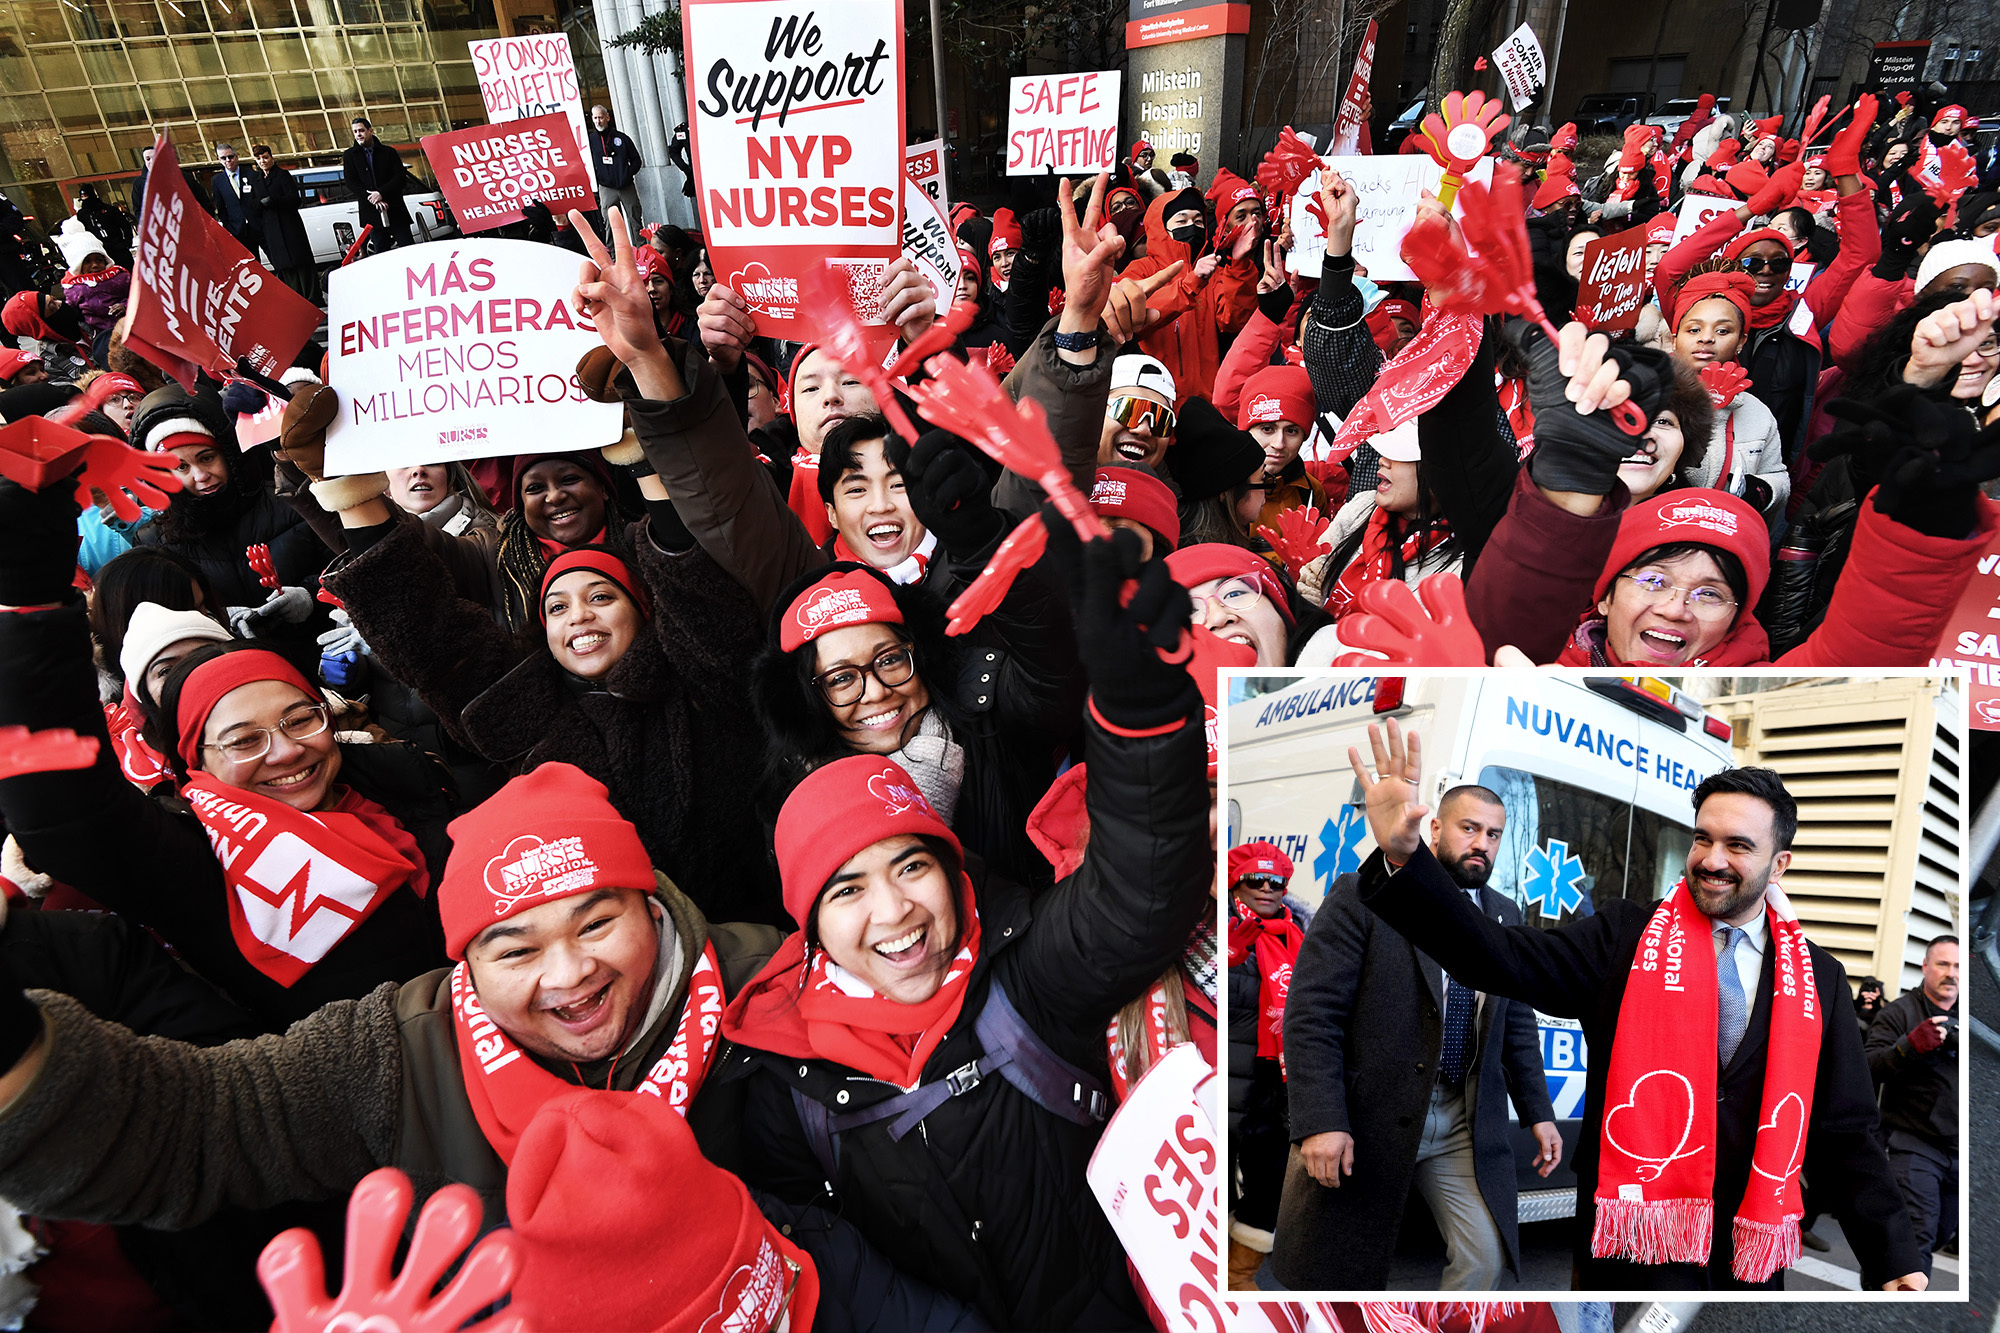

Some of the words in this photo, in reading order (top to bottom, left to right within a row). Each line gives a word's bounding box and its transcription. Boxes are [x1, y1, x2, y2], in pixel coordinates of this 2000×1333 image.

[474, 37, 572, 77] SPONSOR
[764, 11, 823, 63] We
[1527, 44, 1543, 70] FAIR
[1142, 65, 1201, 94] Milstein
[1505, 47, 1517, 63] For
[1513, 62, 1533, 98] Patients
[1505, 67, 1521, 98] Nurses
[1512, 37, 1543, 88] CONTRAC
[1882, 63, 1916, 72] Drop-Off
[1898, 75, 1915, 83] Park
[481, 68, 578, 113] BENEFITS
[698, 39, 890, 132] Support
[1015, 73, 1100, 115] SAFE
[1141, 95, 1203, 126] Hospital
[451, 128, 552, 166] NURSES
[452, 147, 568, 188] DESERVE
[747, 135, 852, 180] NYP
[1009, 126, 1116, 168] STAFFING
[462, 199, 520, 220] HEALTH
[521, 185, 586, 207] BENEFITS
[482, 169, 556, 202] GOOD
[709, 186, 895, 229] NURSES
[140, 192, 167, 294] SAFE
[922, 216, 946, 249] We
[158, 191, 185, 343] NURSES
[406, 251, 496, 300] MÁS
[741, 283, 799, 298] NURSES
[746, 296, 799, 304] ASSOCIATION
[204, 280, 225, 347] AFE
[341, 298, 599, 357] ENFERMERAS
[398, 341, 519, 382] MENOS
[437, 427, 488, 445] NURSES
[1093, 481, 1127, 493] URSES
[1255, 677, 1378, 728] AMBULANCE
[1506, 696, 1649, 774] NUVANCE
[500, 843, 585, 885] NURSES
[1643, 908, 1672, 972] Nurses
[1779, 929, 1797, 997] Nurses
